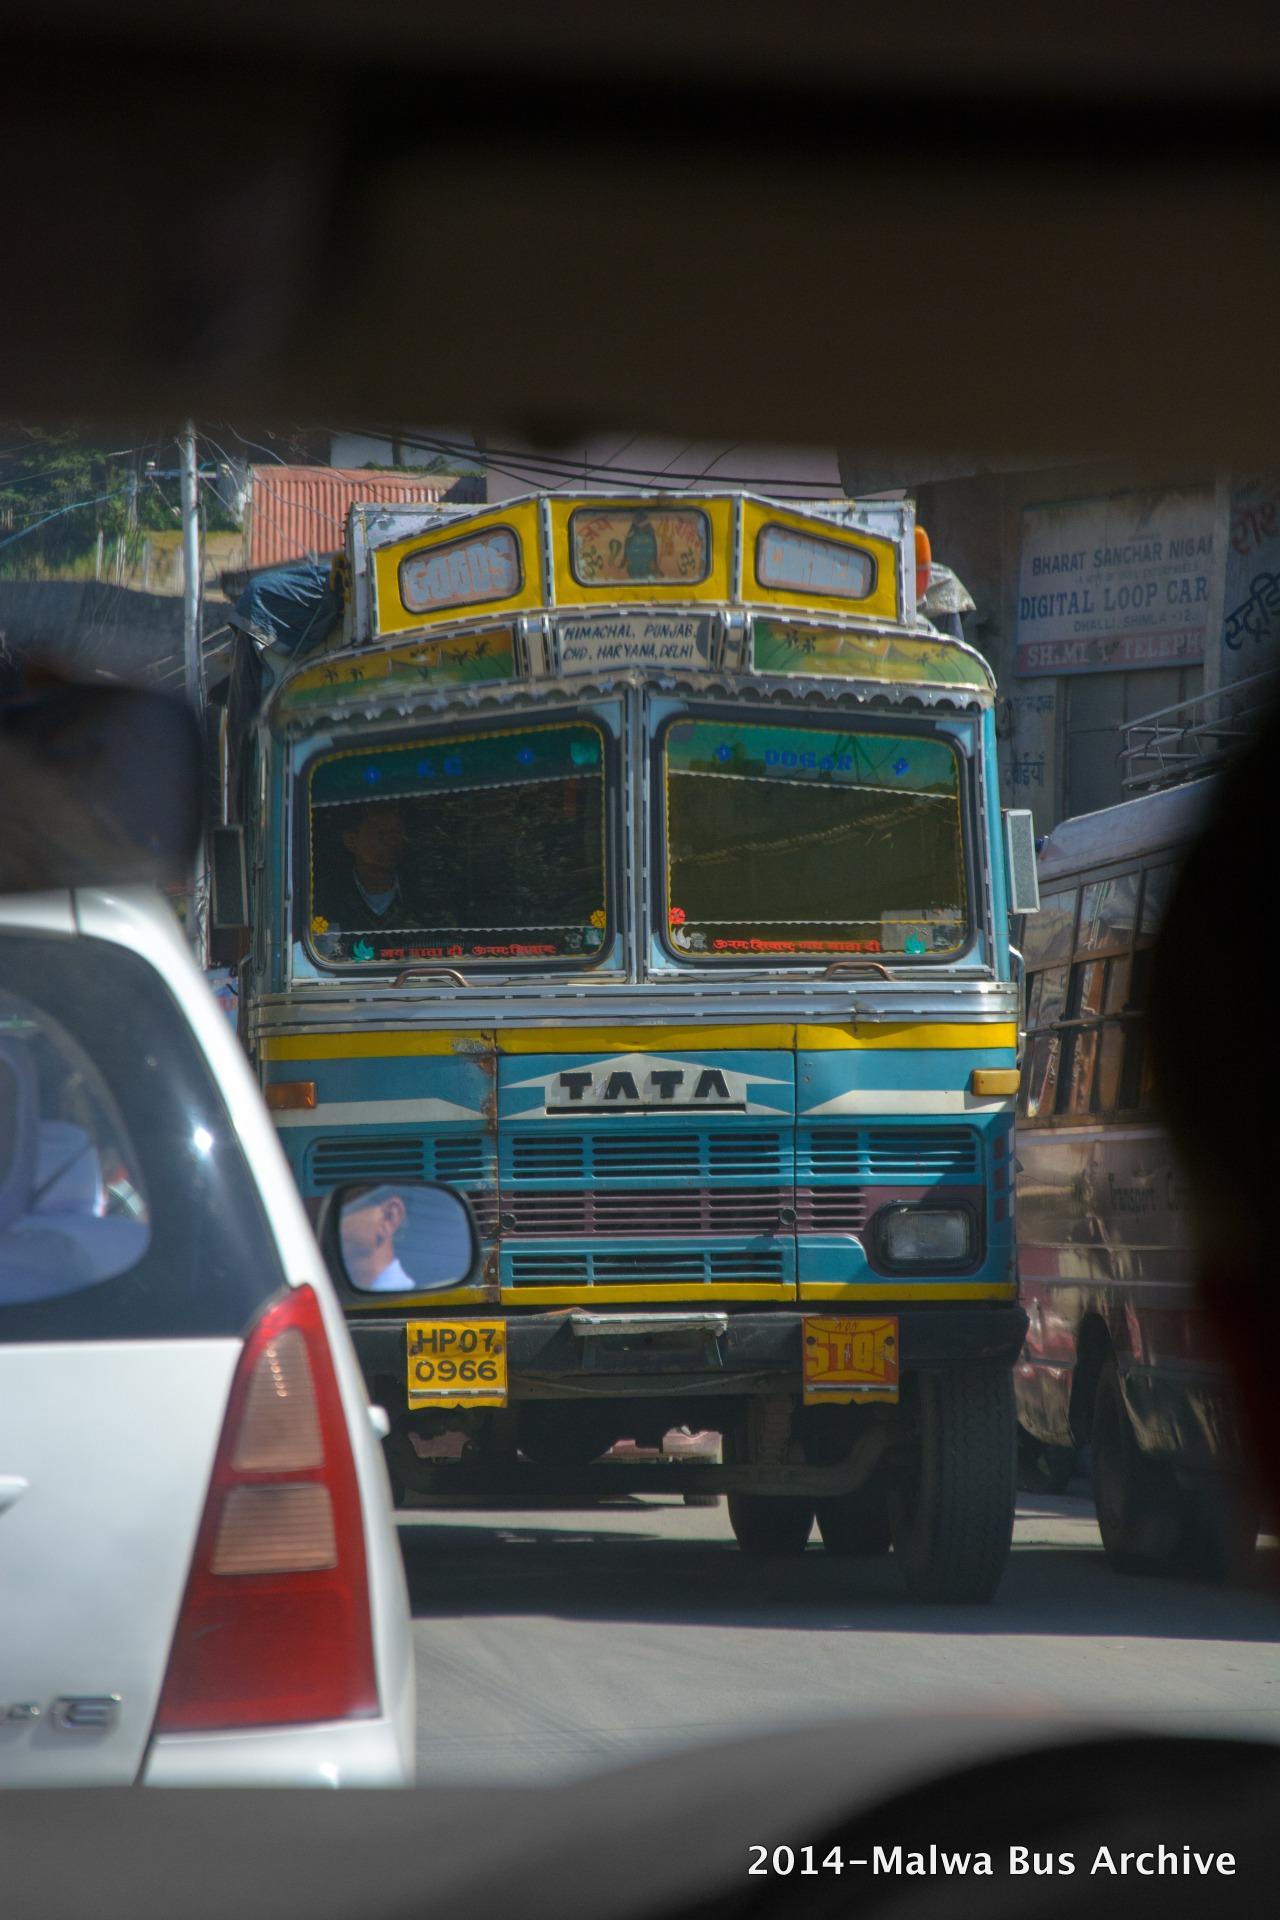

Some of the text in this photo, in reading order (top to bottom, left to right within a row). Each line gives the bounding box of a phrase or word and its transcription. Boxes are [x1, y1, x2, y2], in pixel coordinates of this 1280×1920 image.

[404, 535, 512, 603] GOODS
[1032, 551, 1086, 577] BHARAT
[1093, 541, 1163, 569] SANCHAR
[1019, 588, 1095, 621] DIGITAL
[1103, 581, 1158, 612] LOOP
[1121, 629, 1207, 660] TELEPH
[559, 1069, 731, 1100] TATA
[416, 1328, 496, 1353] HP07
[806, 1331, 896, 1376] STOP
[415, 1359, 497, 1382] 0966
